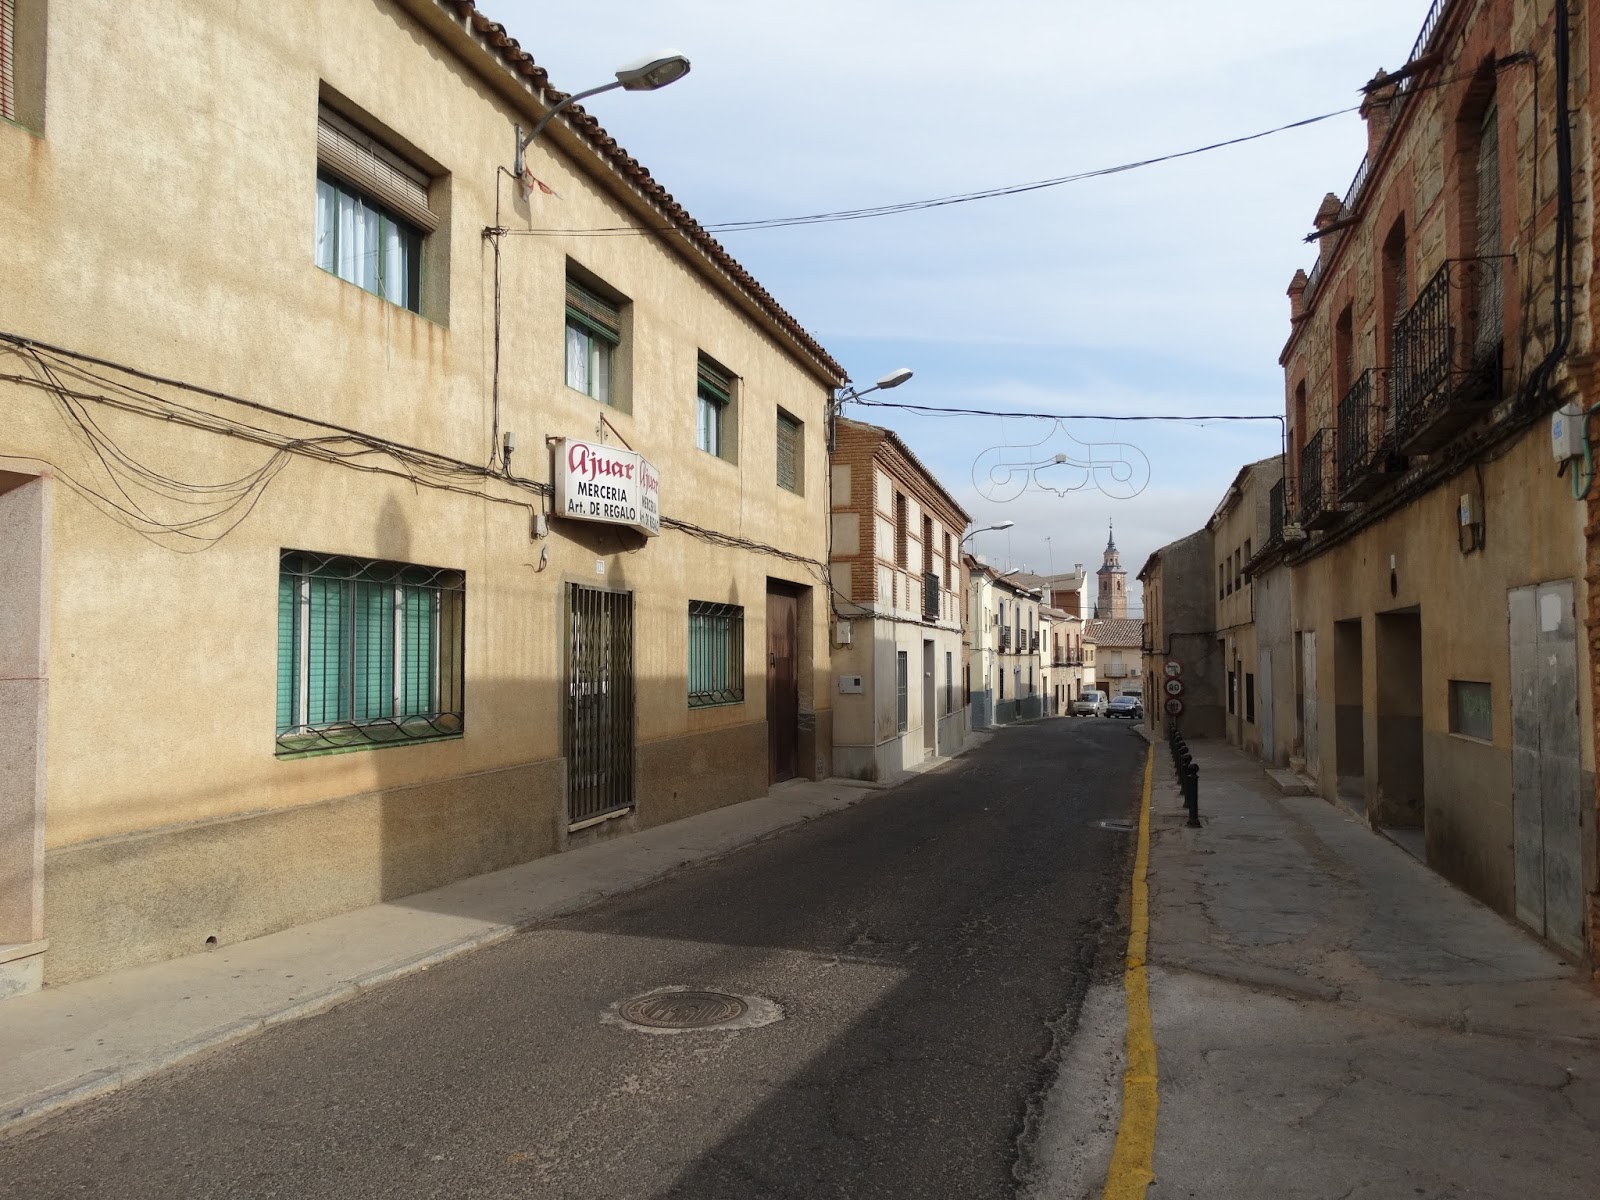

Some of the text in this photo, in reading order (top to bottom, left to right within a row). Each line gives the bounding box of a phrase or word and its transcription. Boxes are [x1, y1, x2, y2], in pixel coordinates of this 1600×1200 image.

[568, 443, 635, 482] Ajuar
[577, 481, 628, 503] MERCERIA
[568, 498, 636, 521] Art. DE REGALO
